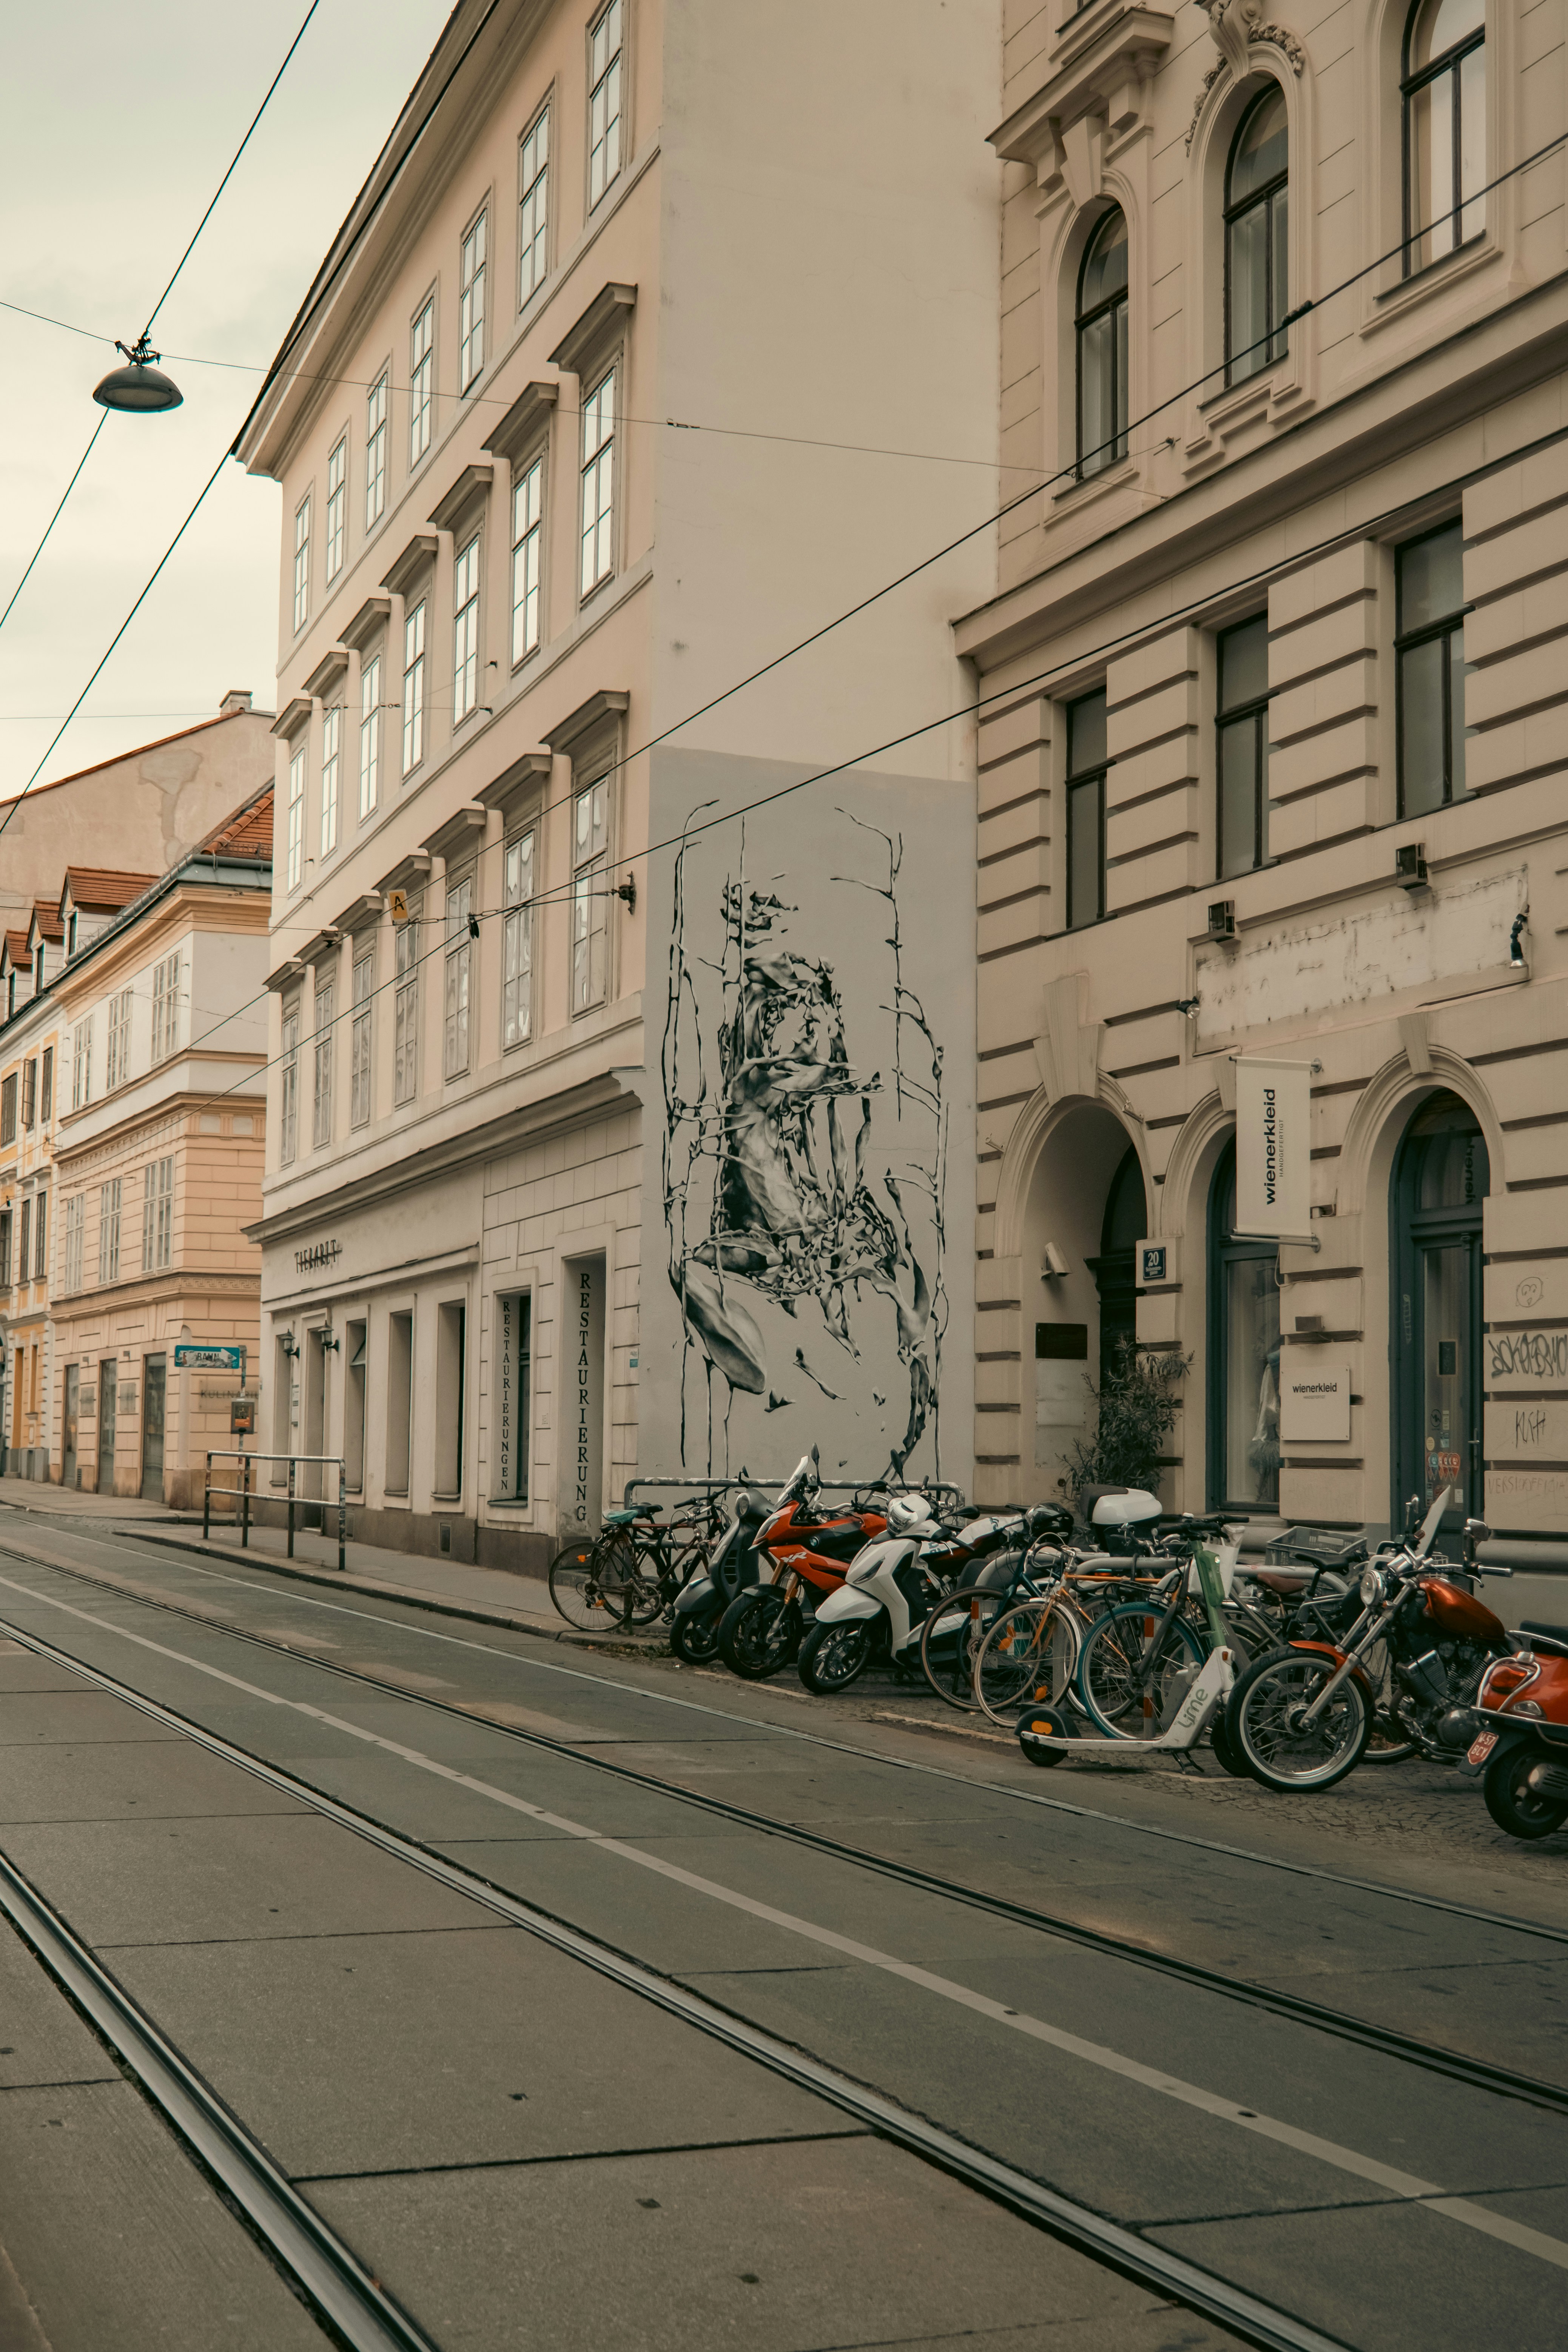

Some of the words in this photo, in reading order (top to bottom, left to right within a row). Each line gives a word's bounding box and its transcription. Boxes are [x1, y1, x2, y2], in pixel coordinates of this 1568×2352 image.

[395, 896, 404, 911] A
[1263, 1089, 1276, 1205] wienerkleid
[294, 1239, 336, 1274] TIERARZT
[1148, 1251, 1159, 1267] 20
[501, 1301, 510, 1490] RESTAURIERUNGEN
[576, 1273, 591, 1522] RESTAURIERUNG
[1292, 1383, 1337, 1393] wienerkleid
[780, 1552, 807, 1563] XR
